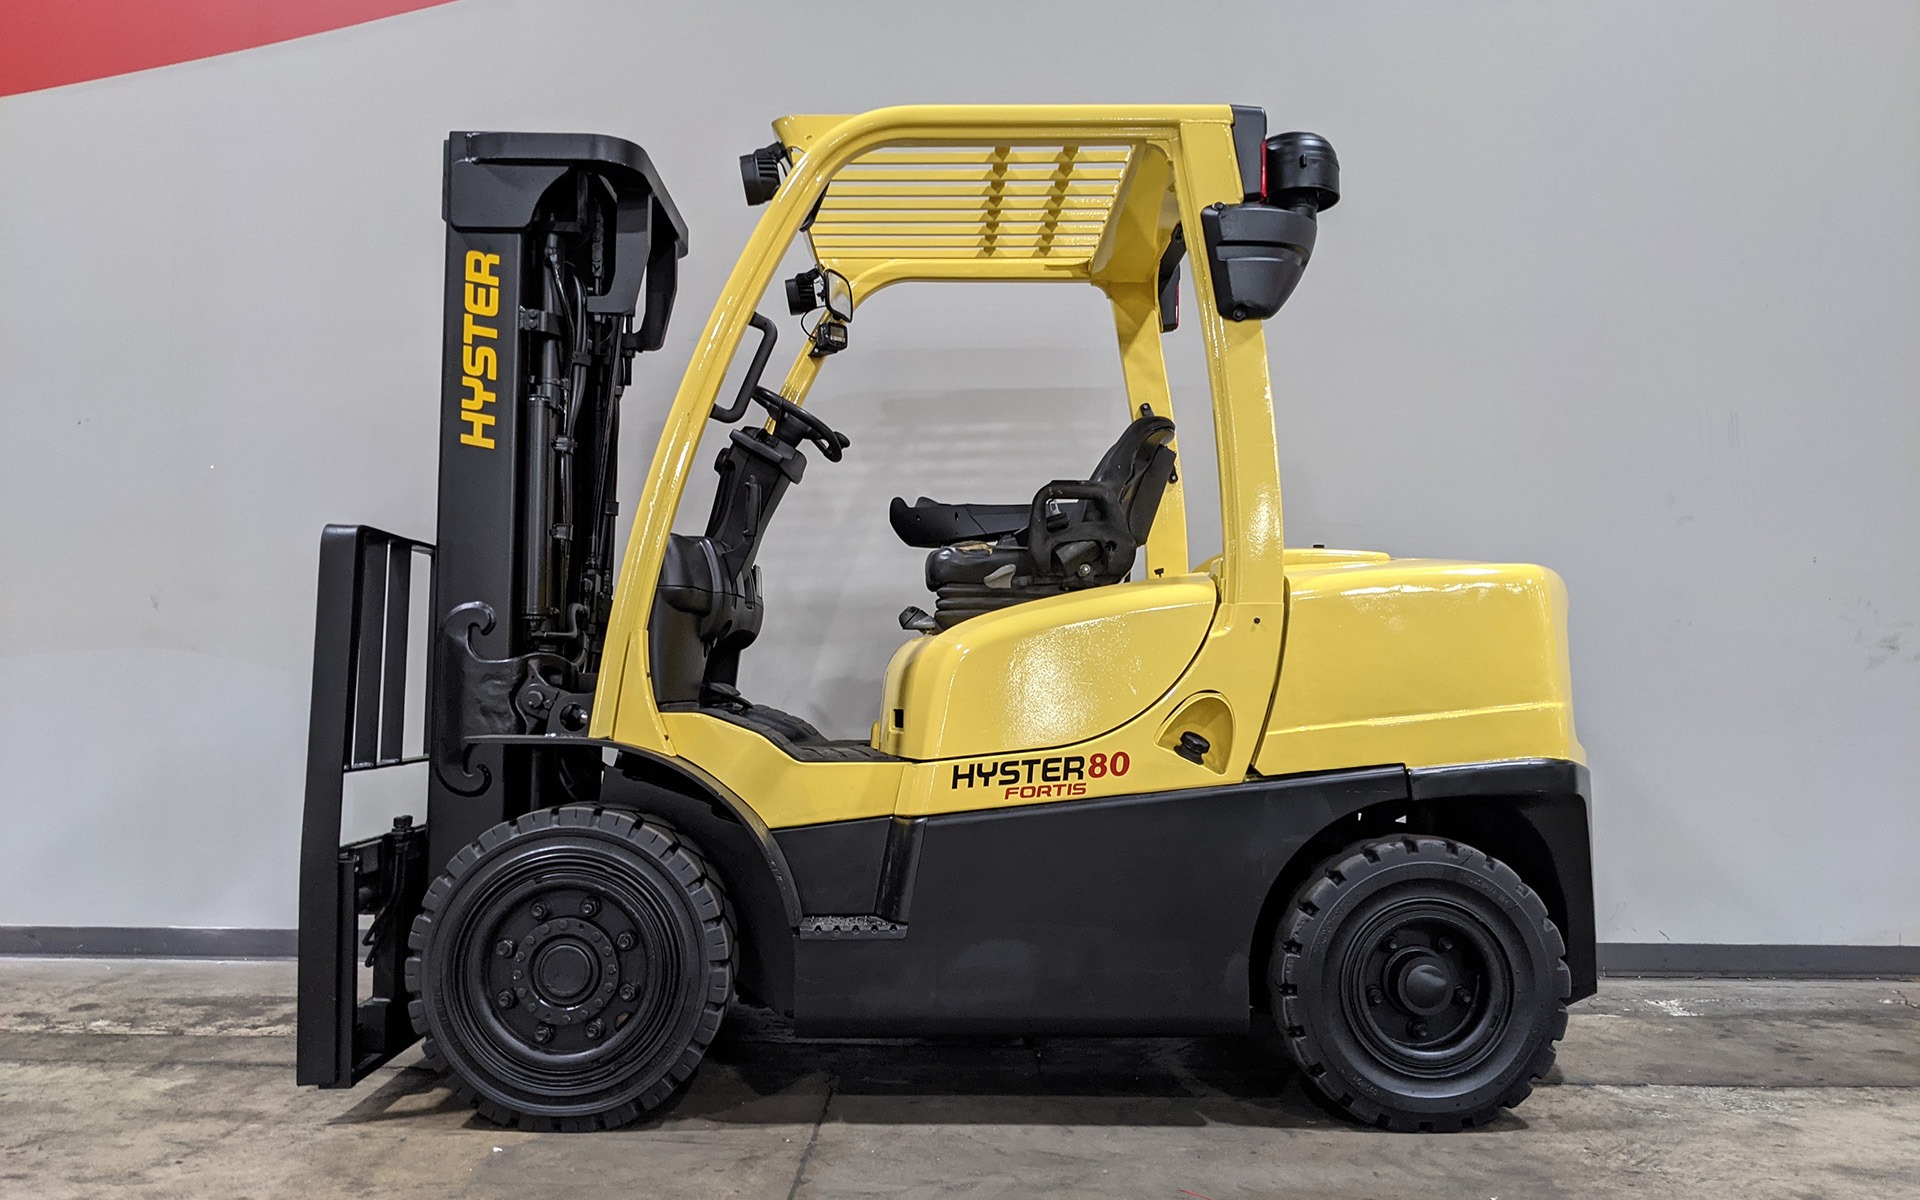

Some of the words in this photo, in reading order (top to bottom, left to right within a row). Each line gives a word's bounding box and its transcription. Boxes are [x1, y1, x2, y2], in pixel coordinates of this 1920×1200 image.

[459, 249, 501, 450] HYSTER
[952, 755, 1085, 790] HYSTER
[1087, 751, 1130, 778] 80
[1004, 782, 1087, 800] FORTIS
